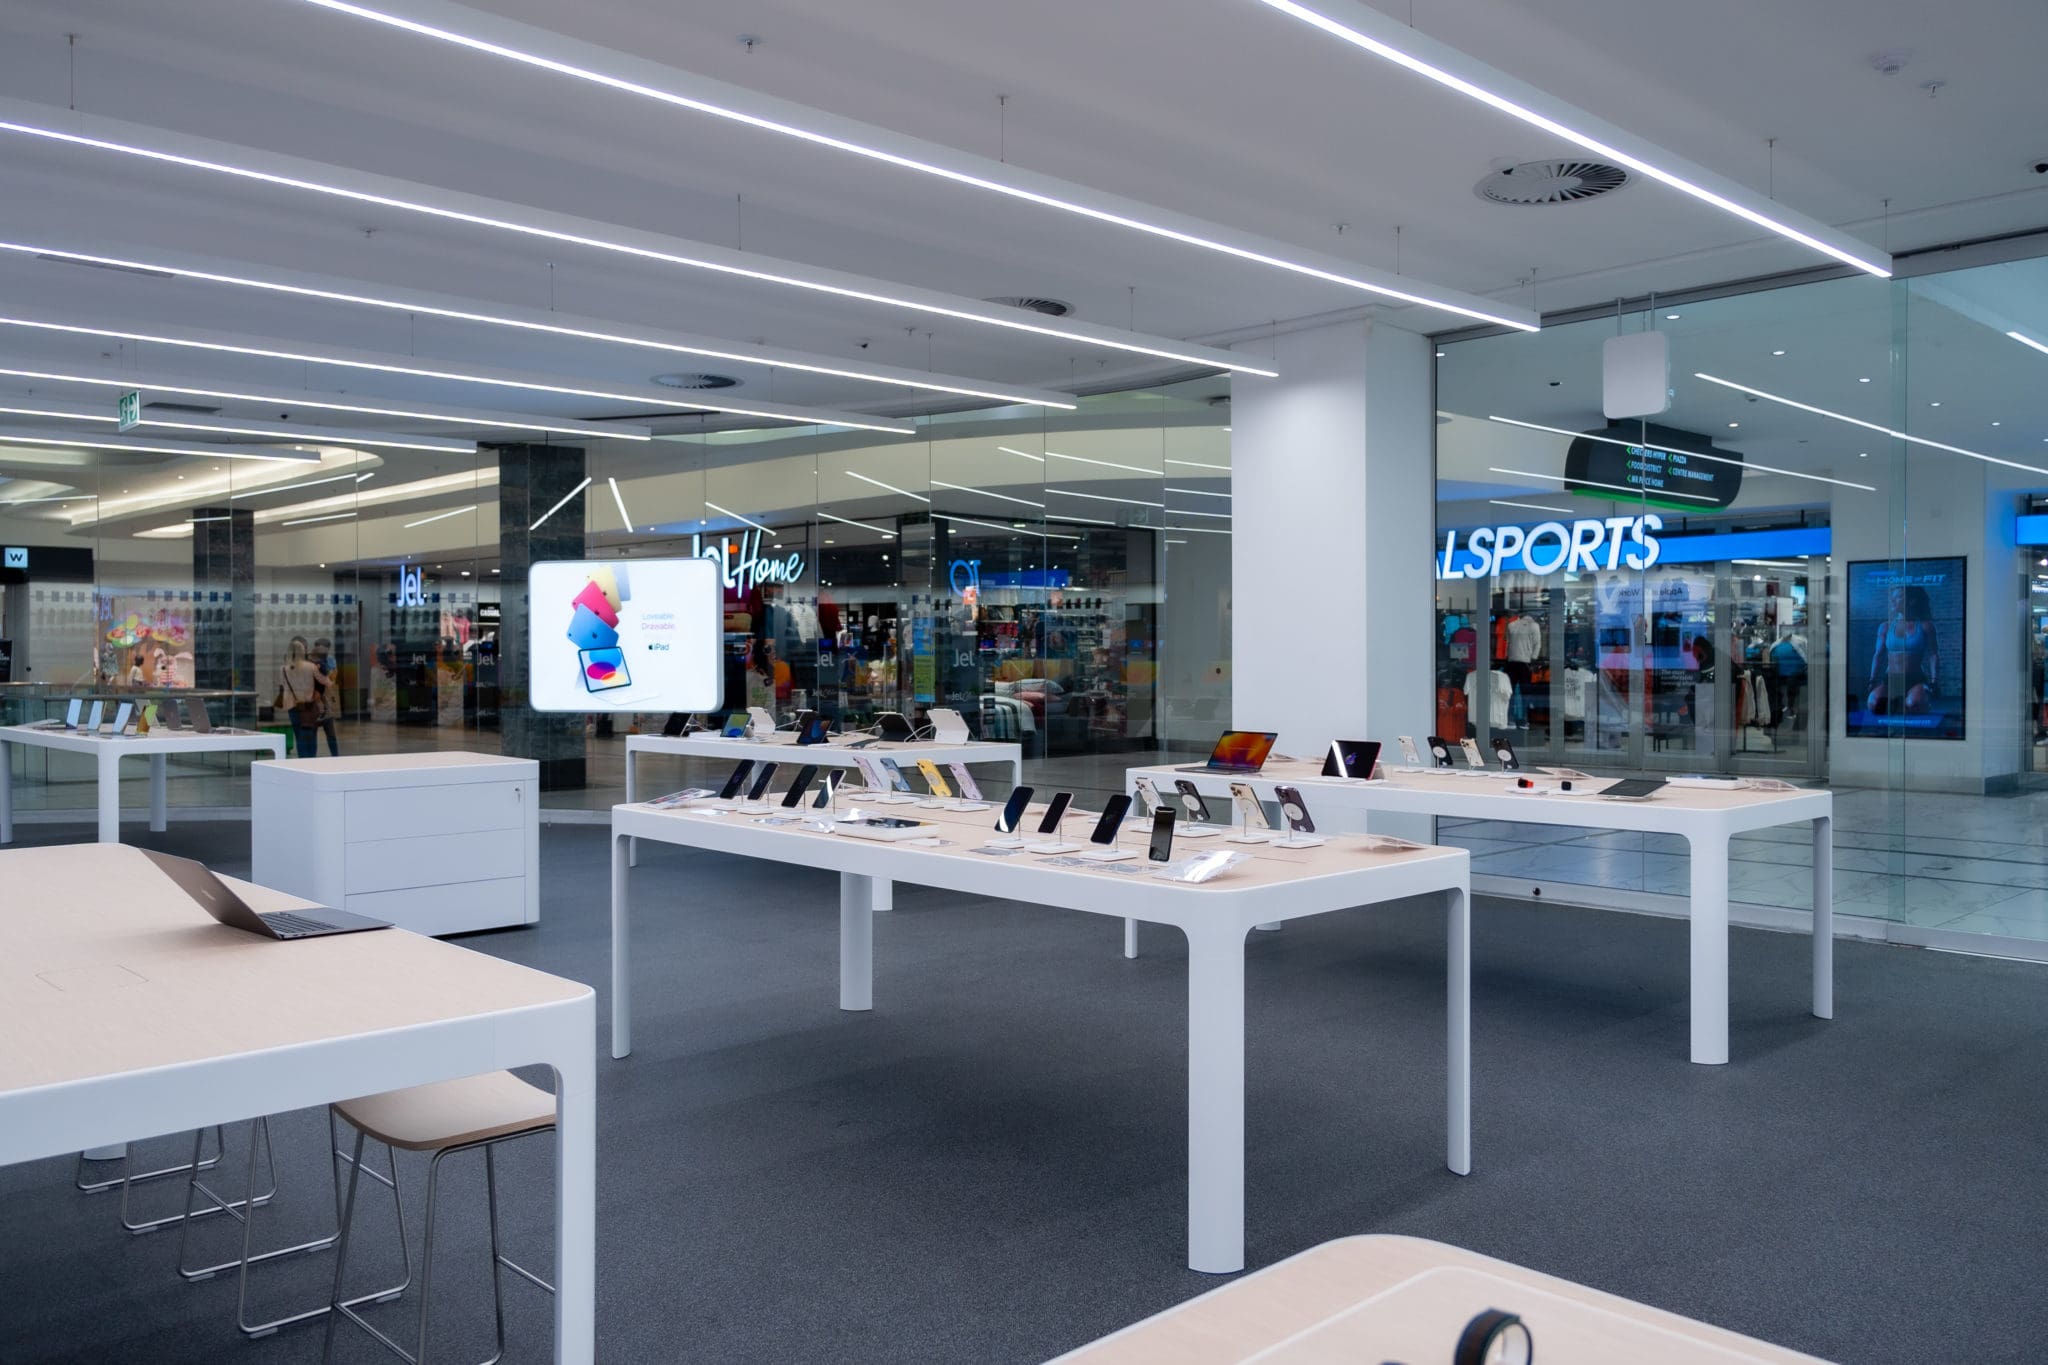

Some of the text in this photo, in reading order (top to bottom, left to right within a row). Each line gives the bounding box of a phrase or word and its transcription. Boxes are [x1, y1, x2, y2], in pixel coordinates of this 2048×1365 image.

[1631, 447, 1653, 457] CHECERS
[1638, 476, 1651, 486] PICE
[731, 528, 805, 599] Home
[1436, 514, 1663, 580] LSPORTS
